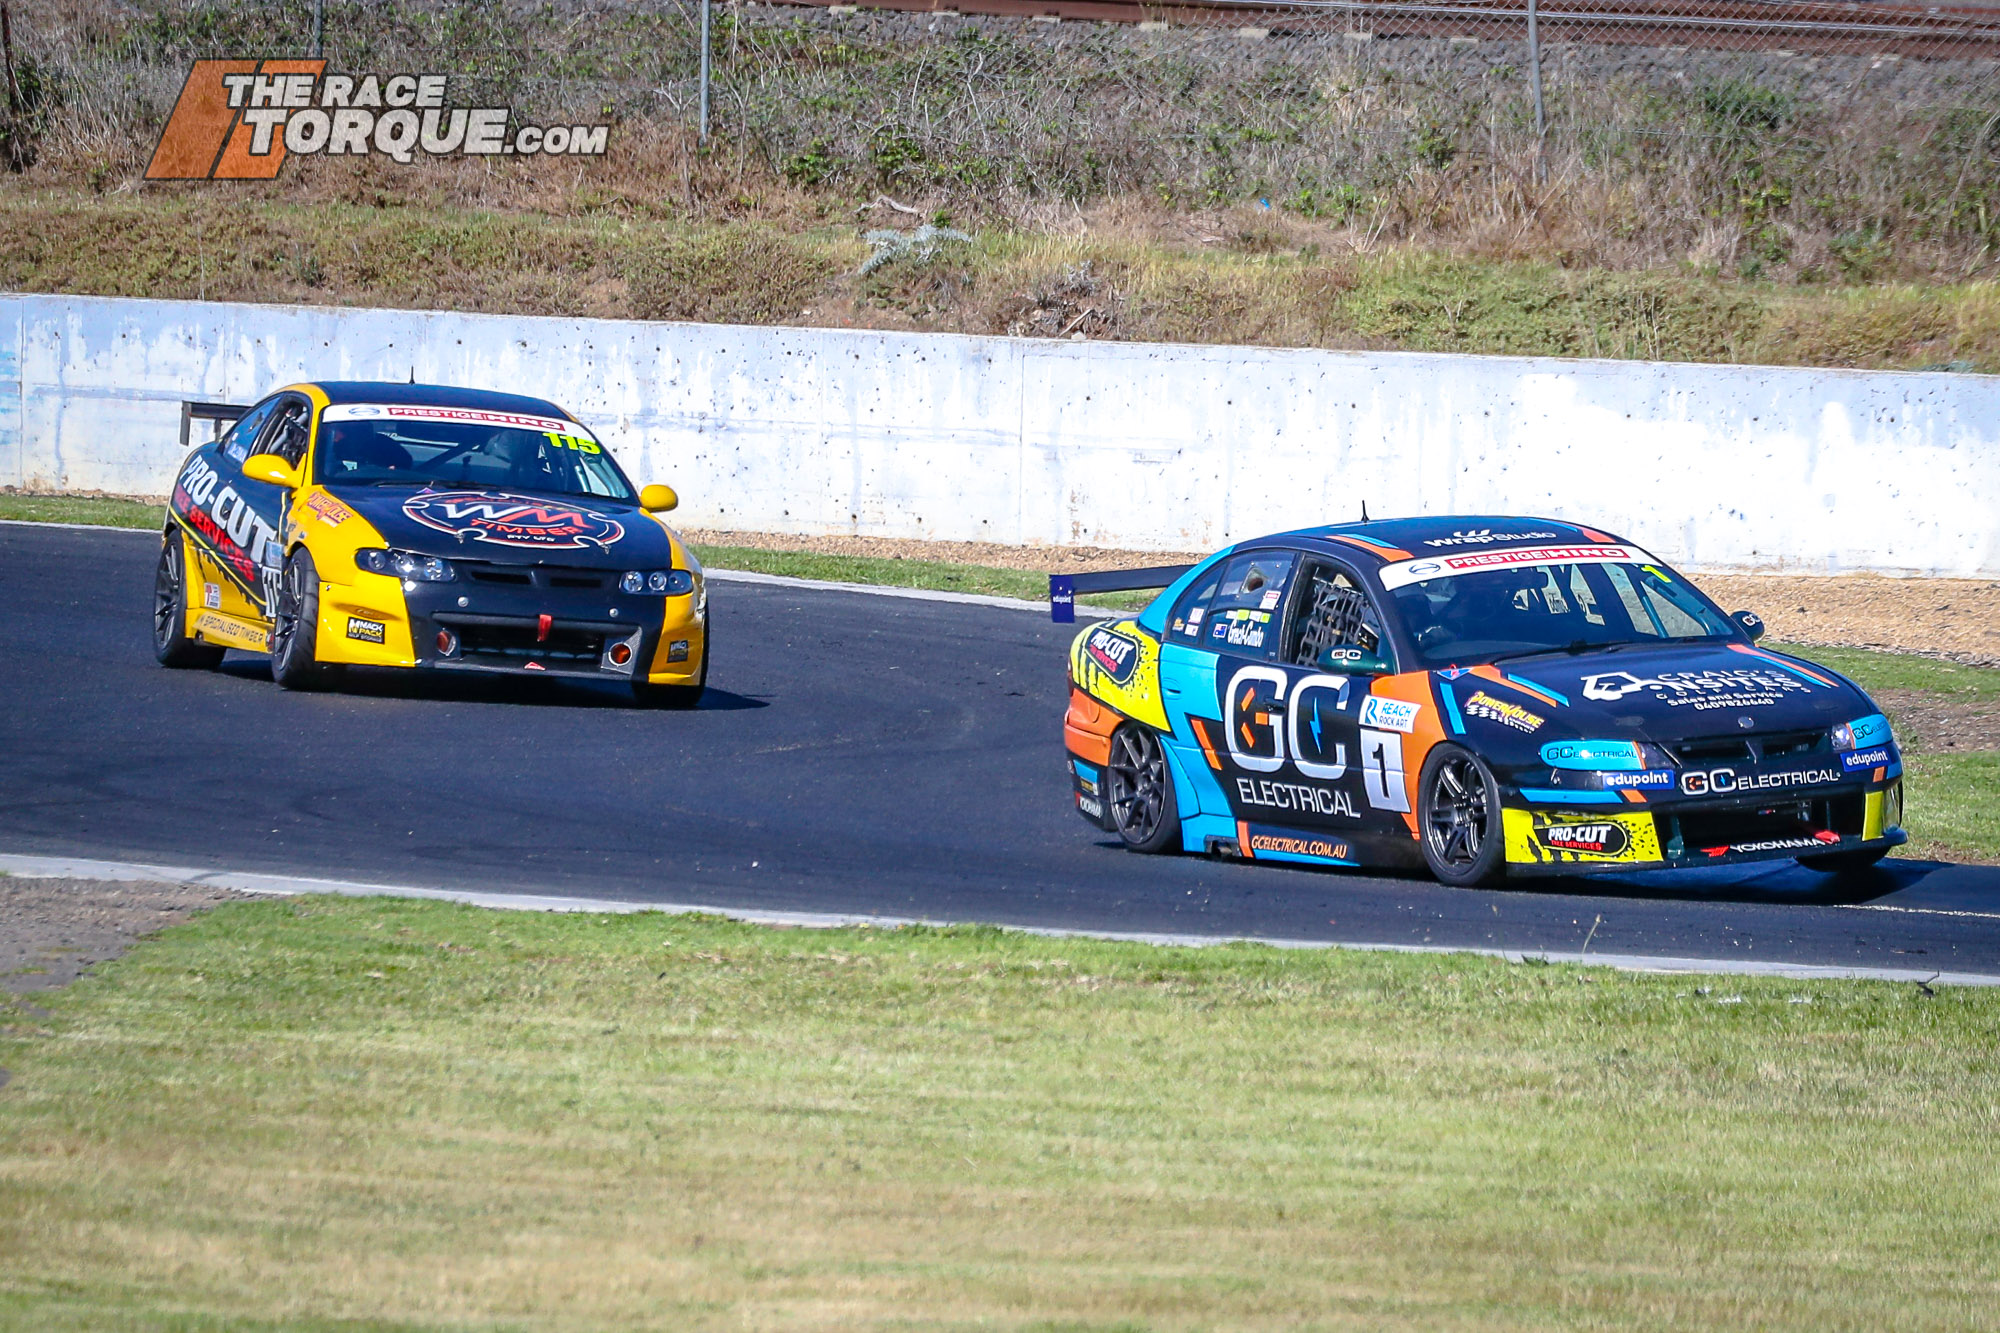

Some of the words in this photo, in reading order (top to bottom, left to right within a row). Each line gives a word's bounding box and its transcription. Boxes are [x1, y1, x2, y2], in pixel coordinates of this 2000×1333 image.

[390, 407, 482, 420] PRESTIGE
[487, 415, 562, 430] HINO
[543, 431, 601, 455] 115
[179, 454, 277, 563] PRO-CUT
[470, 518, 586, 537] TIMBER
[1449, 551, 1544, 568] PRESTIGE
[1548, 548, 1626, 559] HINO
[1640, 565, 1672, 583] 1
[1090, 631, 1134, 665] PRO-CUT
[1331, 649, 1362, 660] GC
[1707, 694, 1732, 702] and
[1382, 702, 1412, 717] REACH
[1224, 665, 1350, 780] GC
[1846, 751, 1888, 766] edupoint
[1372, 742, 1390, 799] 1
[1606, 771, 1669, 787] edupoint
[1236, 778, 1361, 818] ELECTRICAL
[1548, 825, 1611, 843] PRO-CUT
[1251, 835, 1347, 858] GCELECTRICAL.COM.AU
[1565, 841, 1602, 851] SERVICES
[1730, 838, 1826, 853] YOKOHAMA
